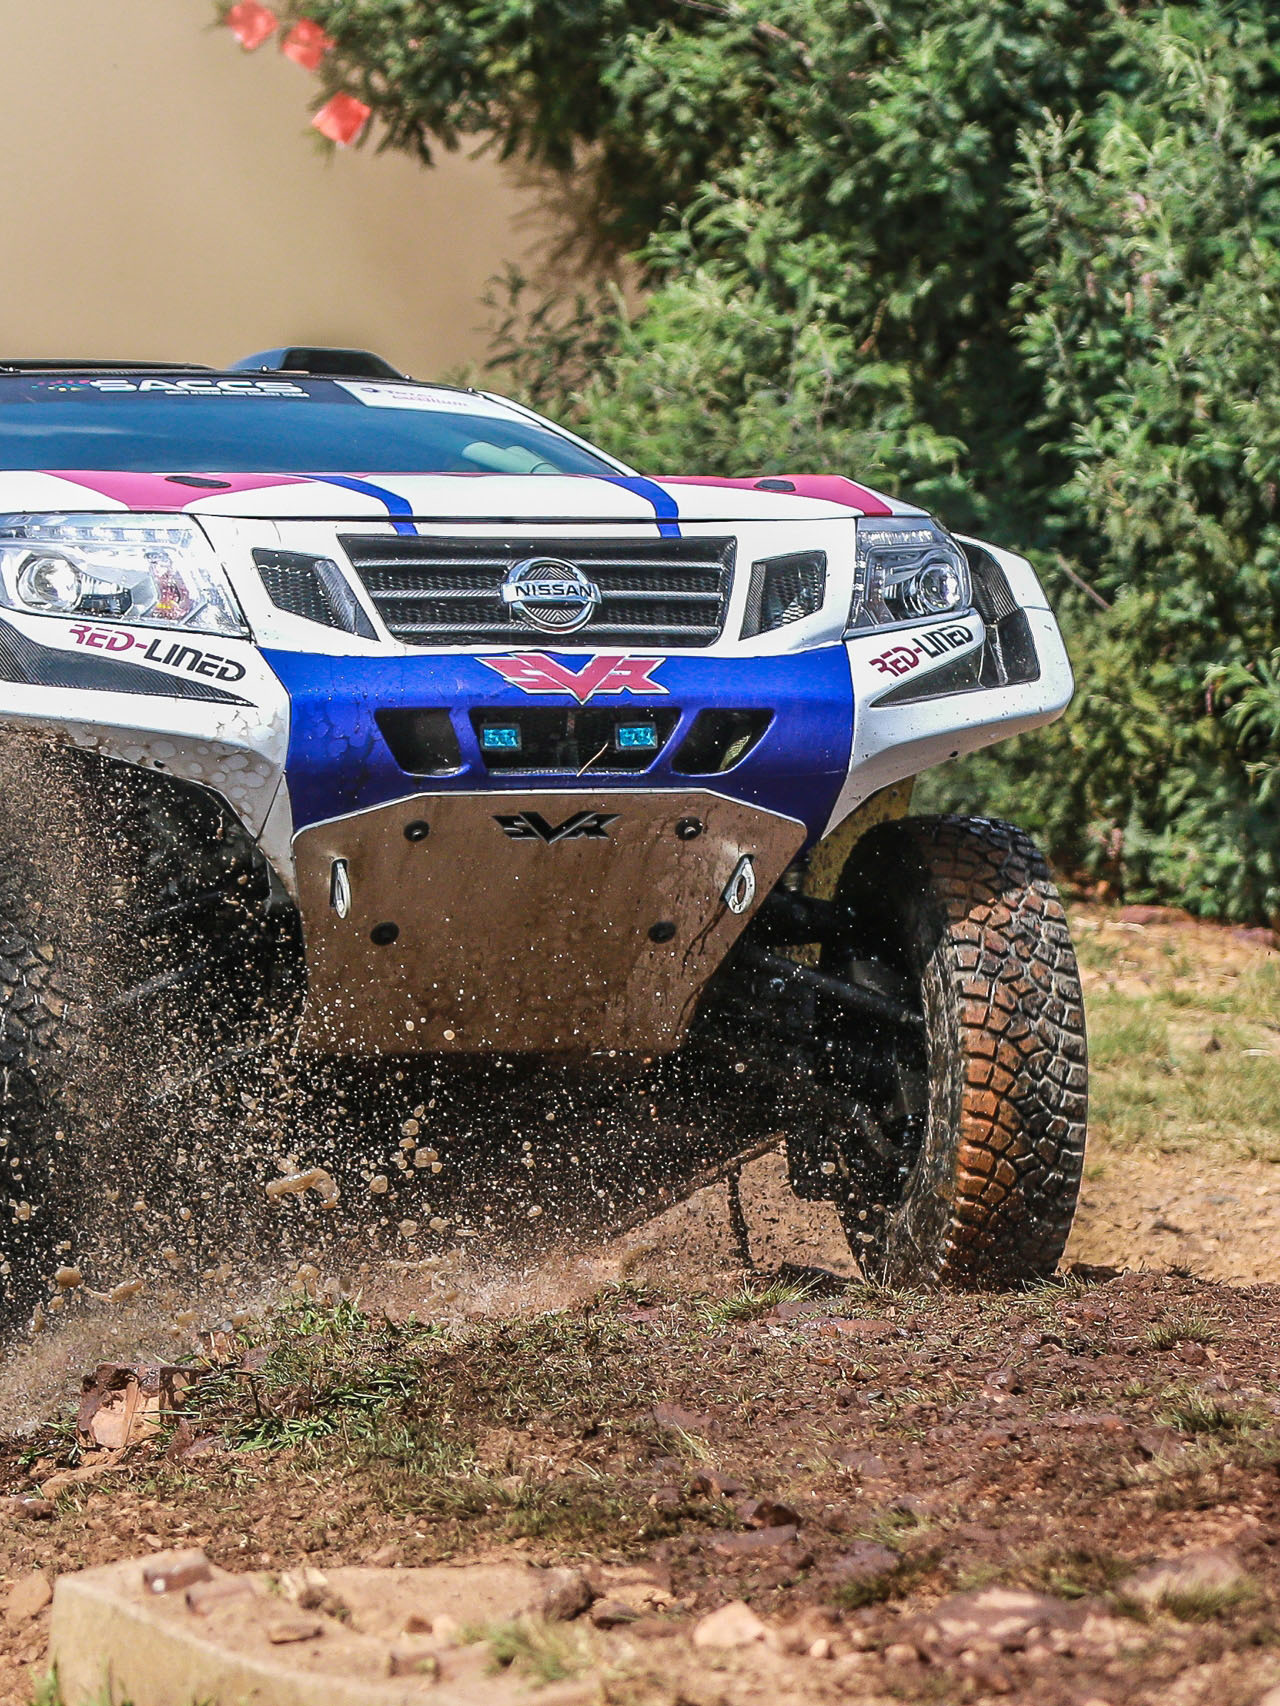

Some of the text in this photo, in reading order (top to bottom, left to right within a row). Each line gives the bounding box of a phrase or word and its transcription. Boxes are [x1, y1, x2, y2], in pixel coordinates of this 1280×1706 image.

[89, 379, 304, 393] SACCS
[515, 583, 593, 598] NISSAN
[69, 623, 247, 682] RED-LINED
[868, 624, 974, 678] RED-LINED
[472, 651, 671, 706] SVR
[490, 809, 624, 845] SVR
